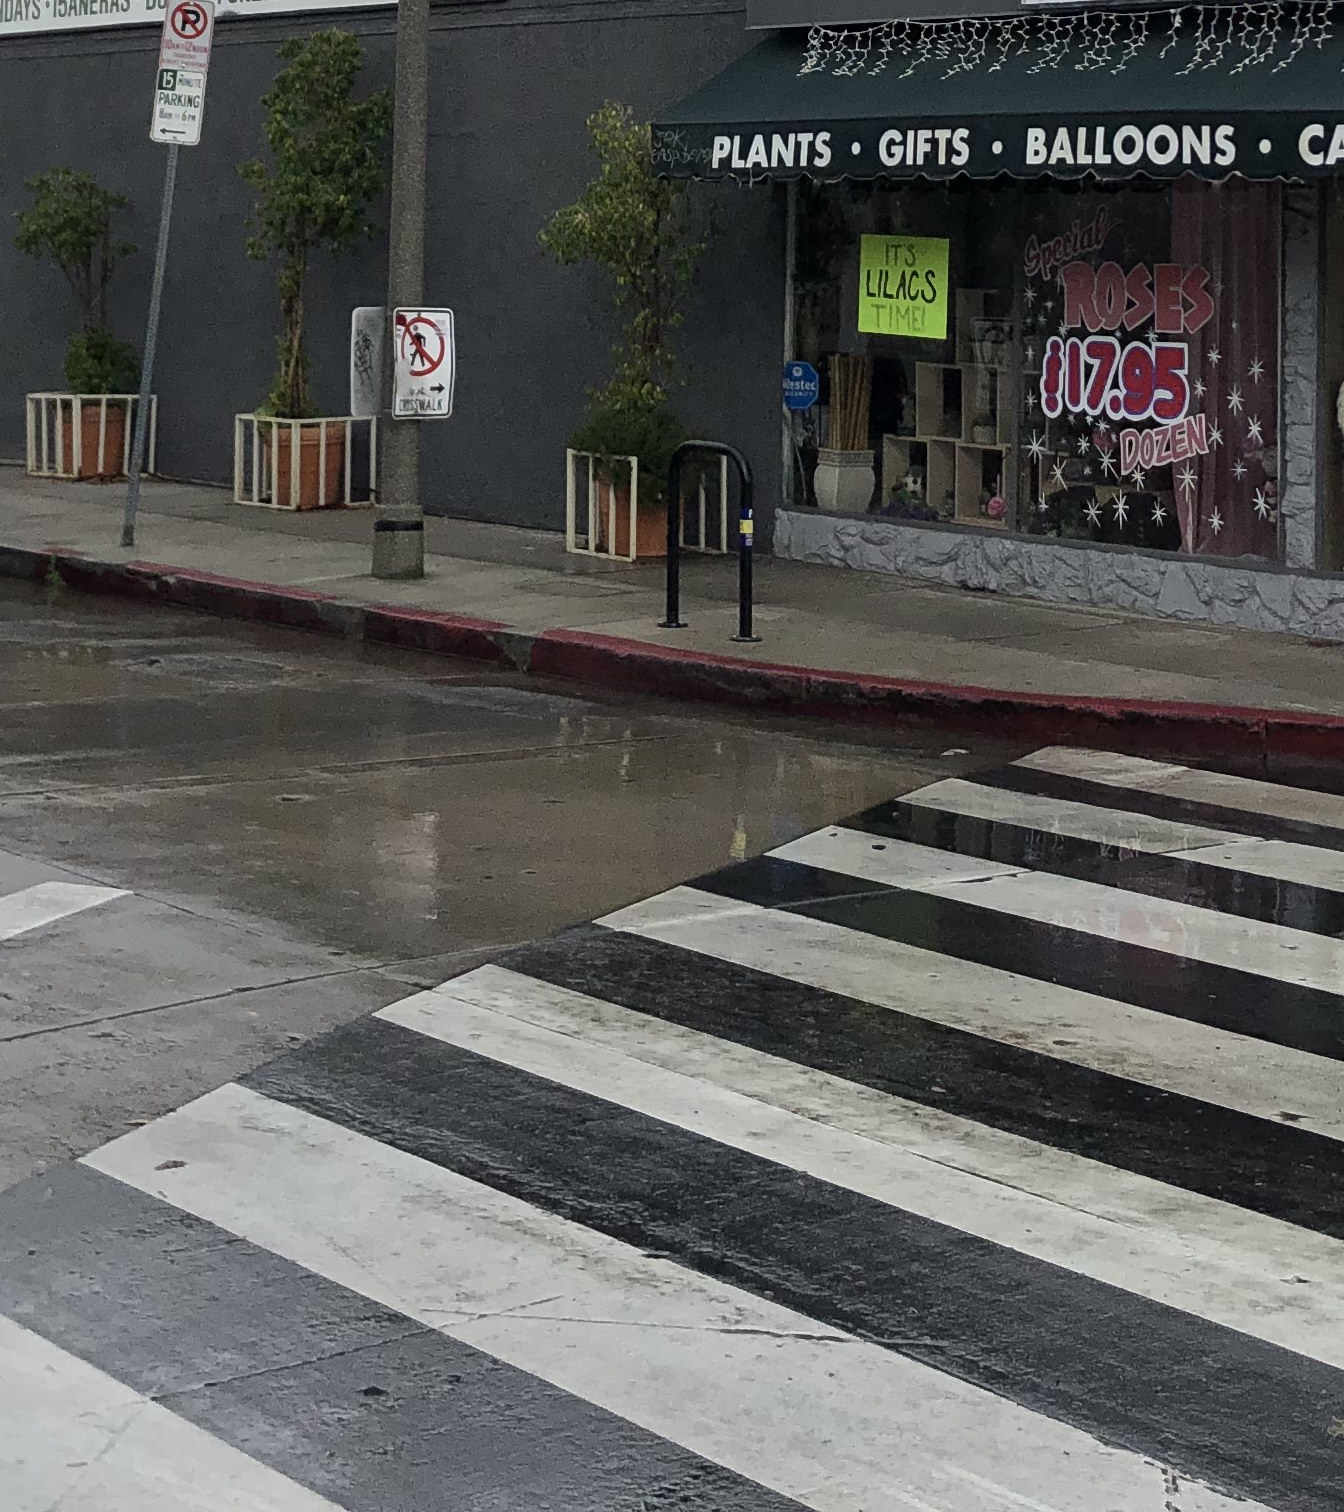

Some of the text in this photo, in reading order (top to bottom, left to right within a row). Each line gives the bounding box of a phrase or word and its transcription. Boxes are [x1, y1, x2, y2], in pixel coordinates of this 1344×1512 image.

[162, 71, 174, 88] 15
[158, 91, 201, 109] PARKING
[712, 131, 833, 169] PLANTS
[878, 127, 971, 168] GIFTS
[1024, 124, 1237, 167] BALLOONS
[885, 243, 917, 268] IT'S
[1023, 204, 1110, 281] Special
[866, 269, 937, 304] LILACS
[1061, 260, 1215, 334] ROSES
[1119, 413, 1210, 476] DOZEN
